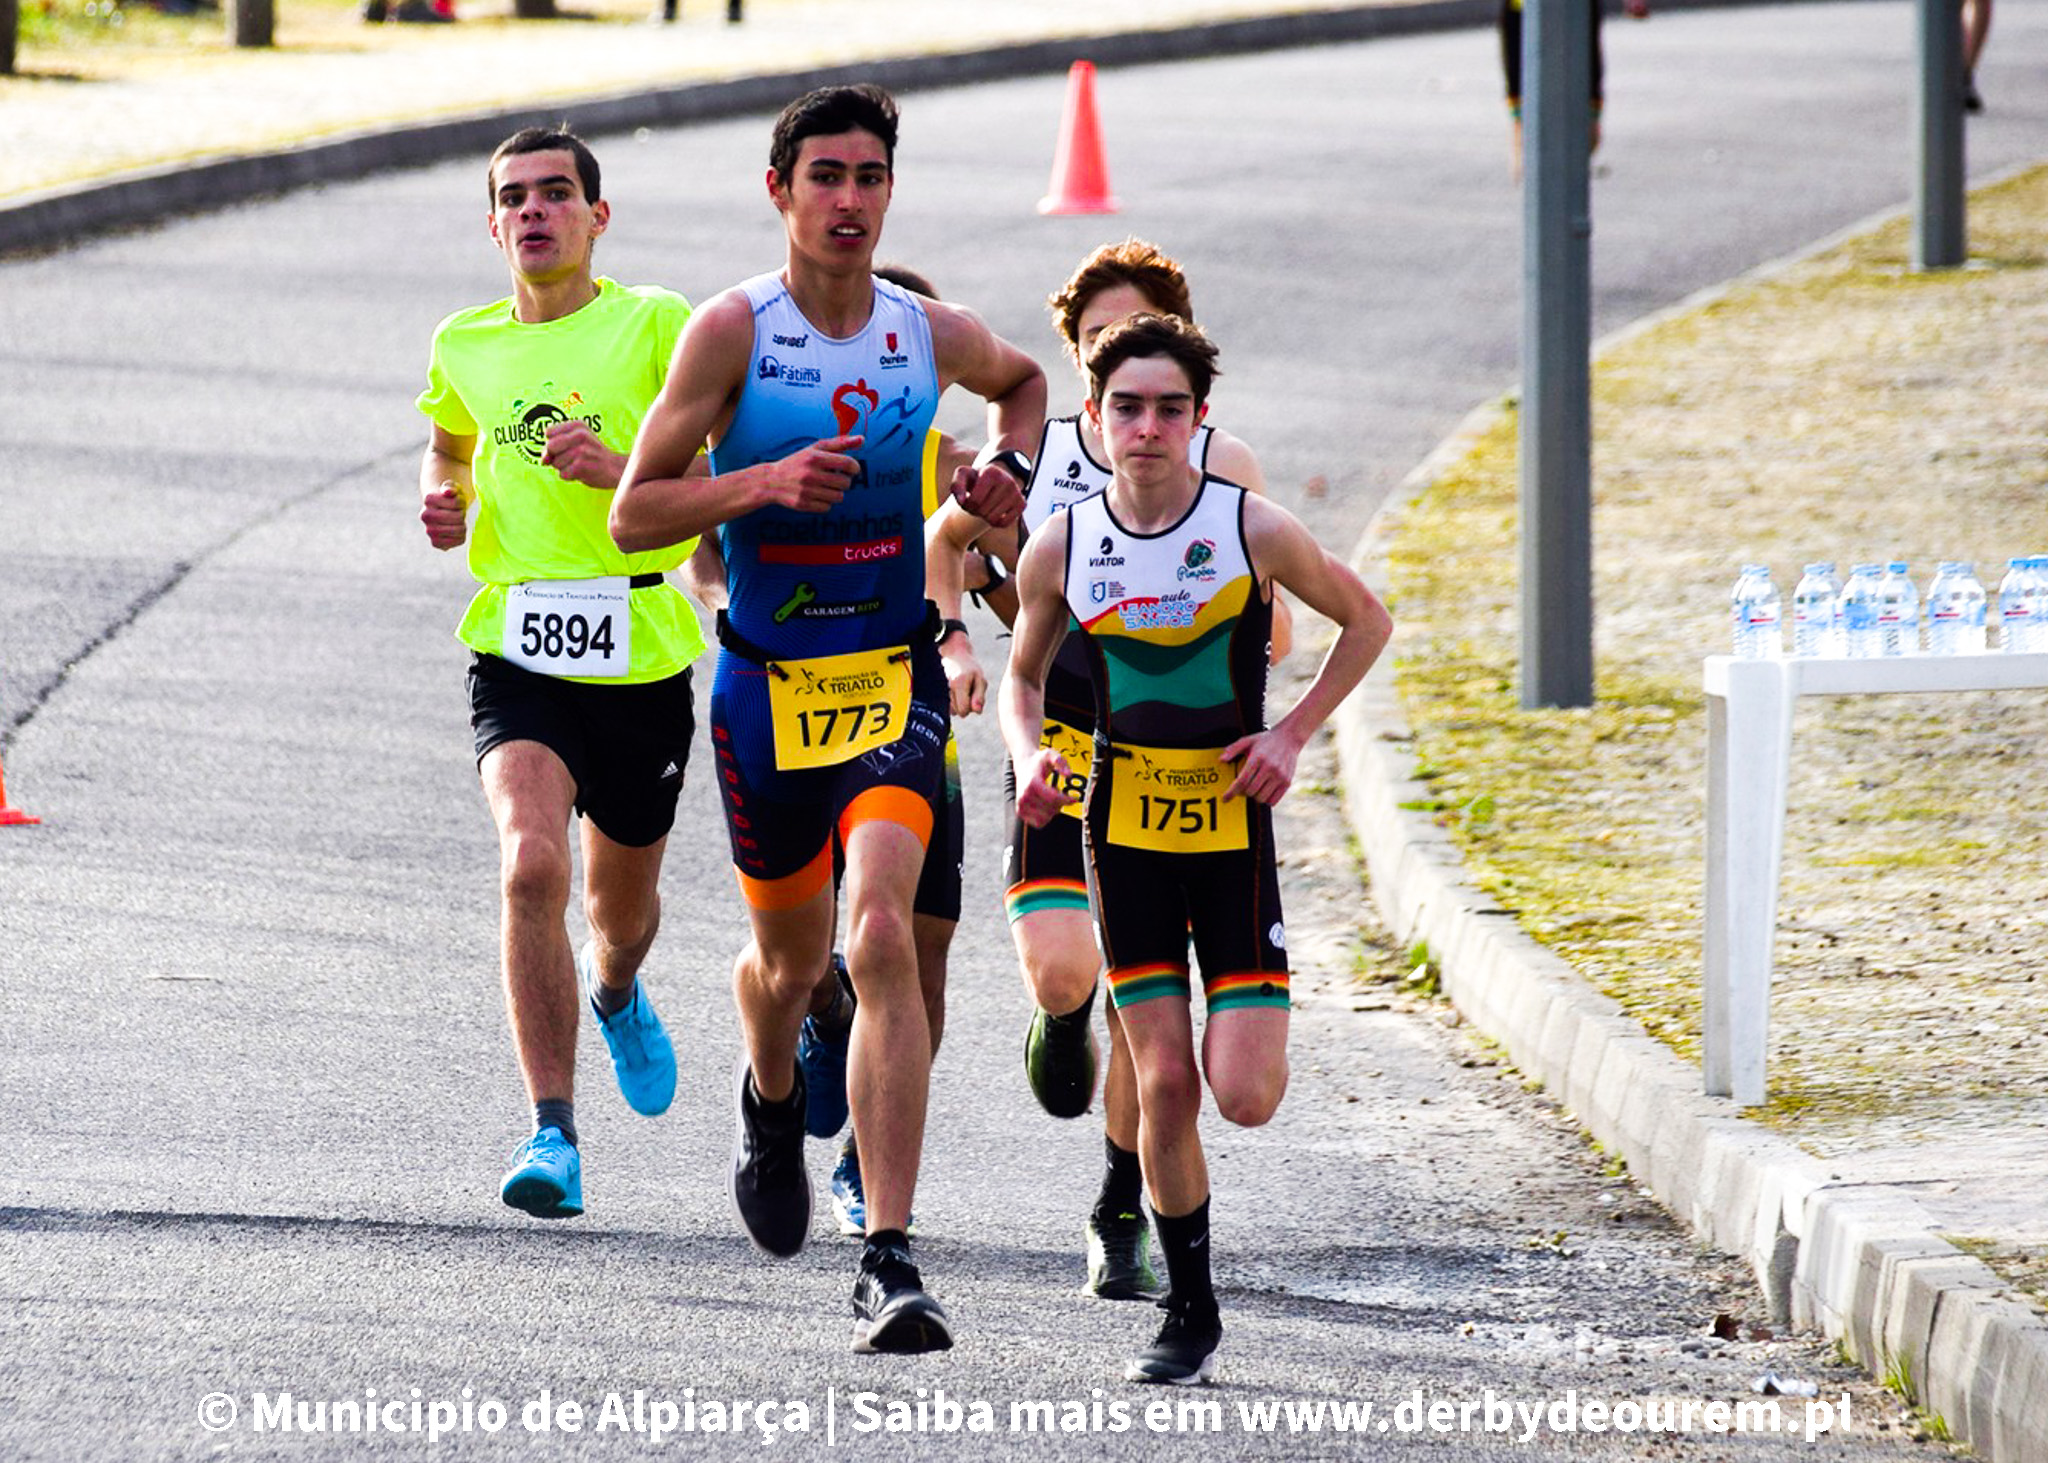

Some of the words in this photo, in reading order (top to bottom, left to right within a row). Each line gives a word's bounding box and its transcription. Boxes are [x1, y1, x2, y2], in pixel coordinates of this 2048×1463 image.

[780, 364, 821, 383] Fátima
[1053, 478, 1090, 493] VIATOR
[844, 541, 896, 561] trucks
[1089, 556, 1125, 567] VIATOR
[804, 604, 856, 616] GARAGEM
[1119, 601, 1196, 617] LEANDRO
[1125, 613, 1194, 630] SANTOS
[521, 612, 615, 659] 5894
[829, 676, 884, 694] TRIATLO
[797, 702, 892, 748] 1773
[1166, 772, 1219, 786] TRIATLO
[1139, 794, 1218, 834] 1751
